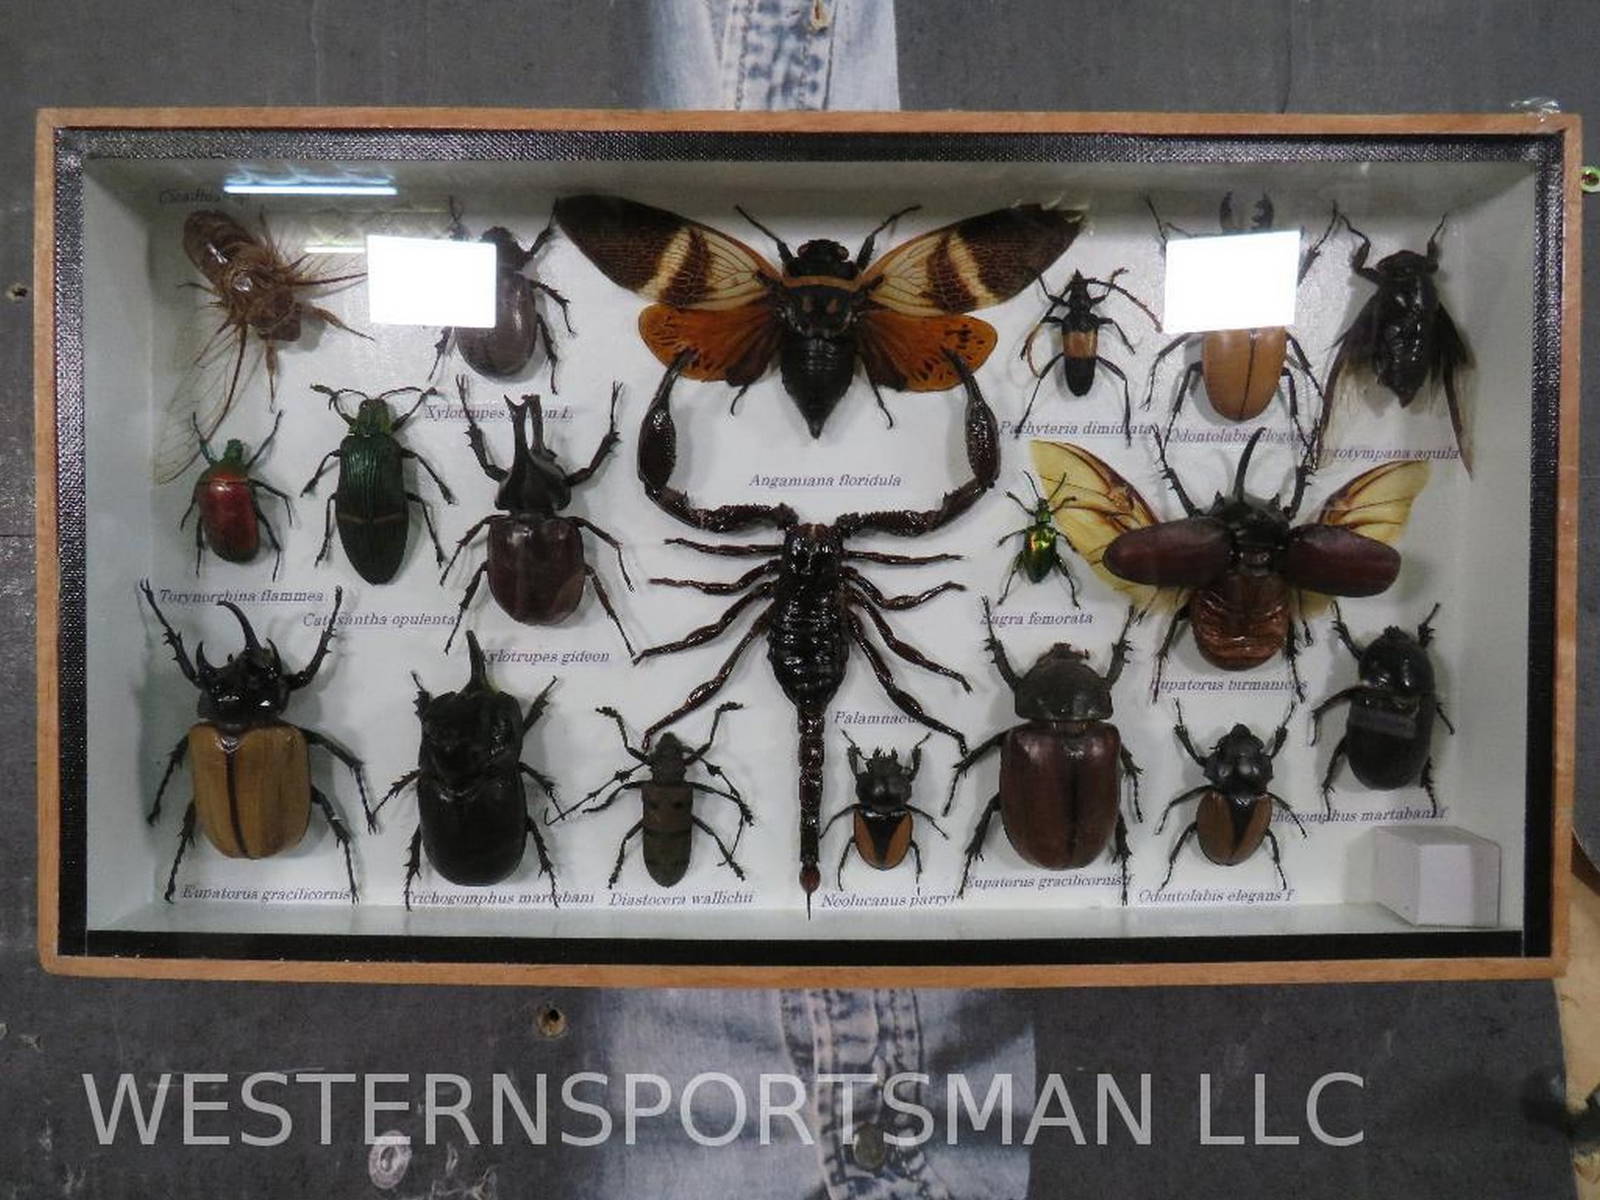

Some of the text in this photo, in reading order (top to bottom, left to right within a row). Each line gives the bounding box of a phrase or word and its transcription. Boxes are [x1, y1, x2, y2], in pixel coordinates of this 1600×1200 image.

[750, 472, 902, 488] Angamiana floridula
[392, 612, 456, 628] opulenta
[1027, 611, 1092, 625] femorata
[561, 649, 610, 665] gideon
[183, 886, 258, 901] Eupatorus
[609, 892, 686, 906] Diastocera
[822, 893, 906, 908] Neolucanus
[1139, 888, 1223, 904] Odontolabis
[1227, 888, 1281, 904] elegans
